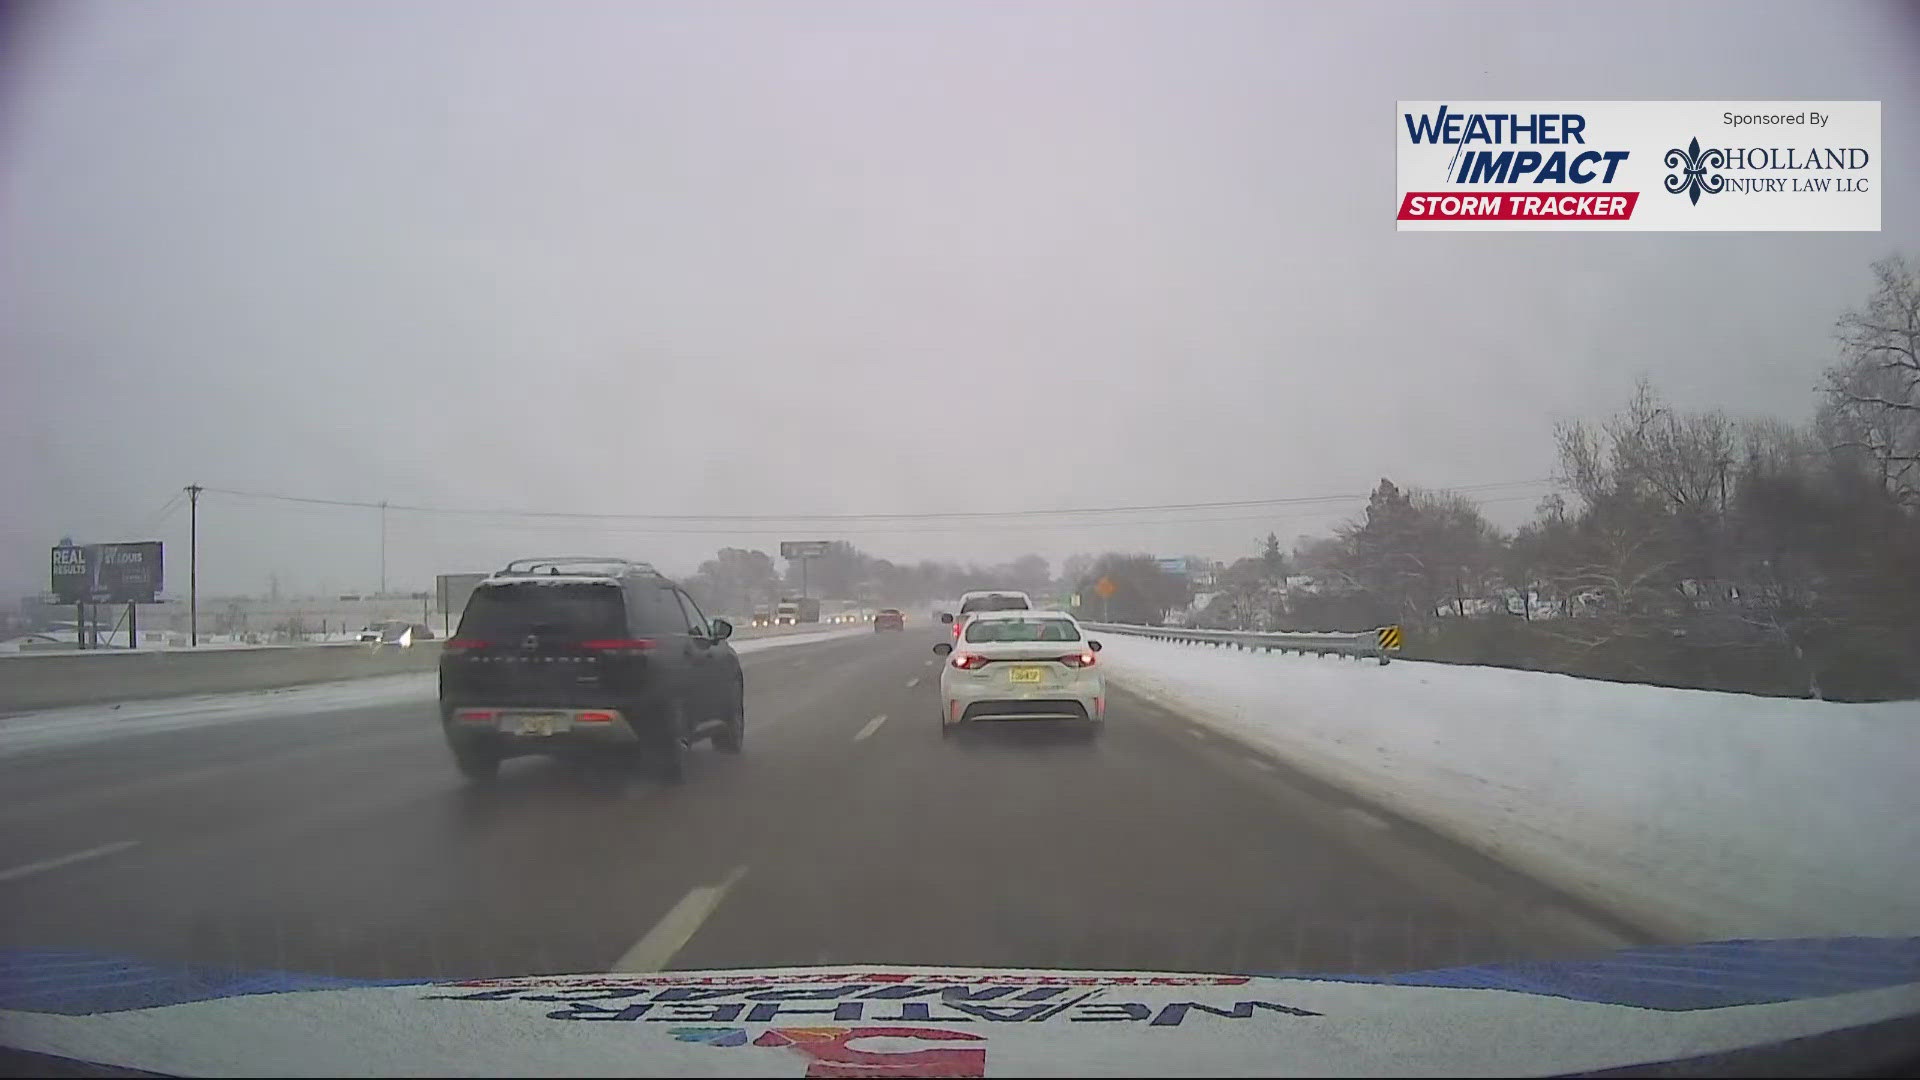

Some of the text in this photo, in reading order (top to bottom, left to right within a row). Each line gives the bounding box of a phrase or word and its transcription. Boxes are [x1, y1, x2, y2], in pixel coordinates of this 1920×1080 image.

[52, 548, 86, 565] REAL
[53, 564, 86, 575] RESULTS
[545, 1001, 1325, 1025] WEATHER
